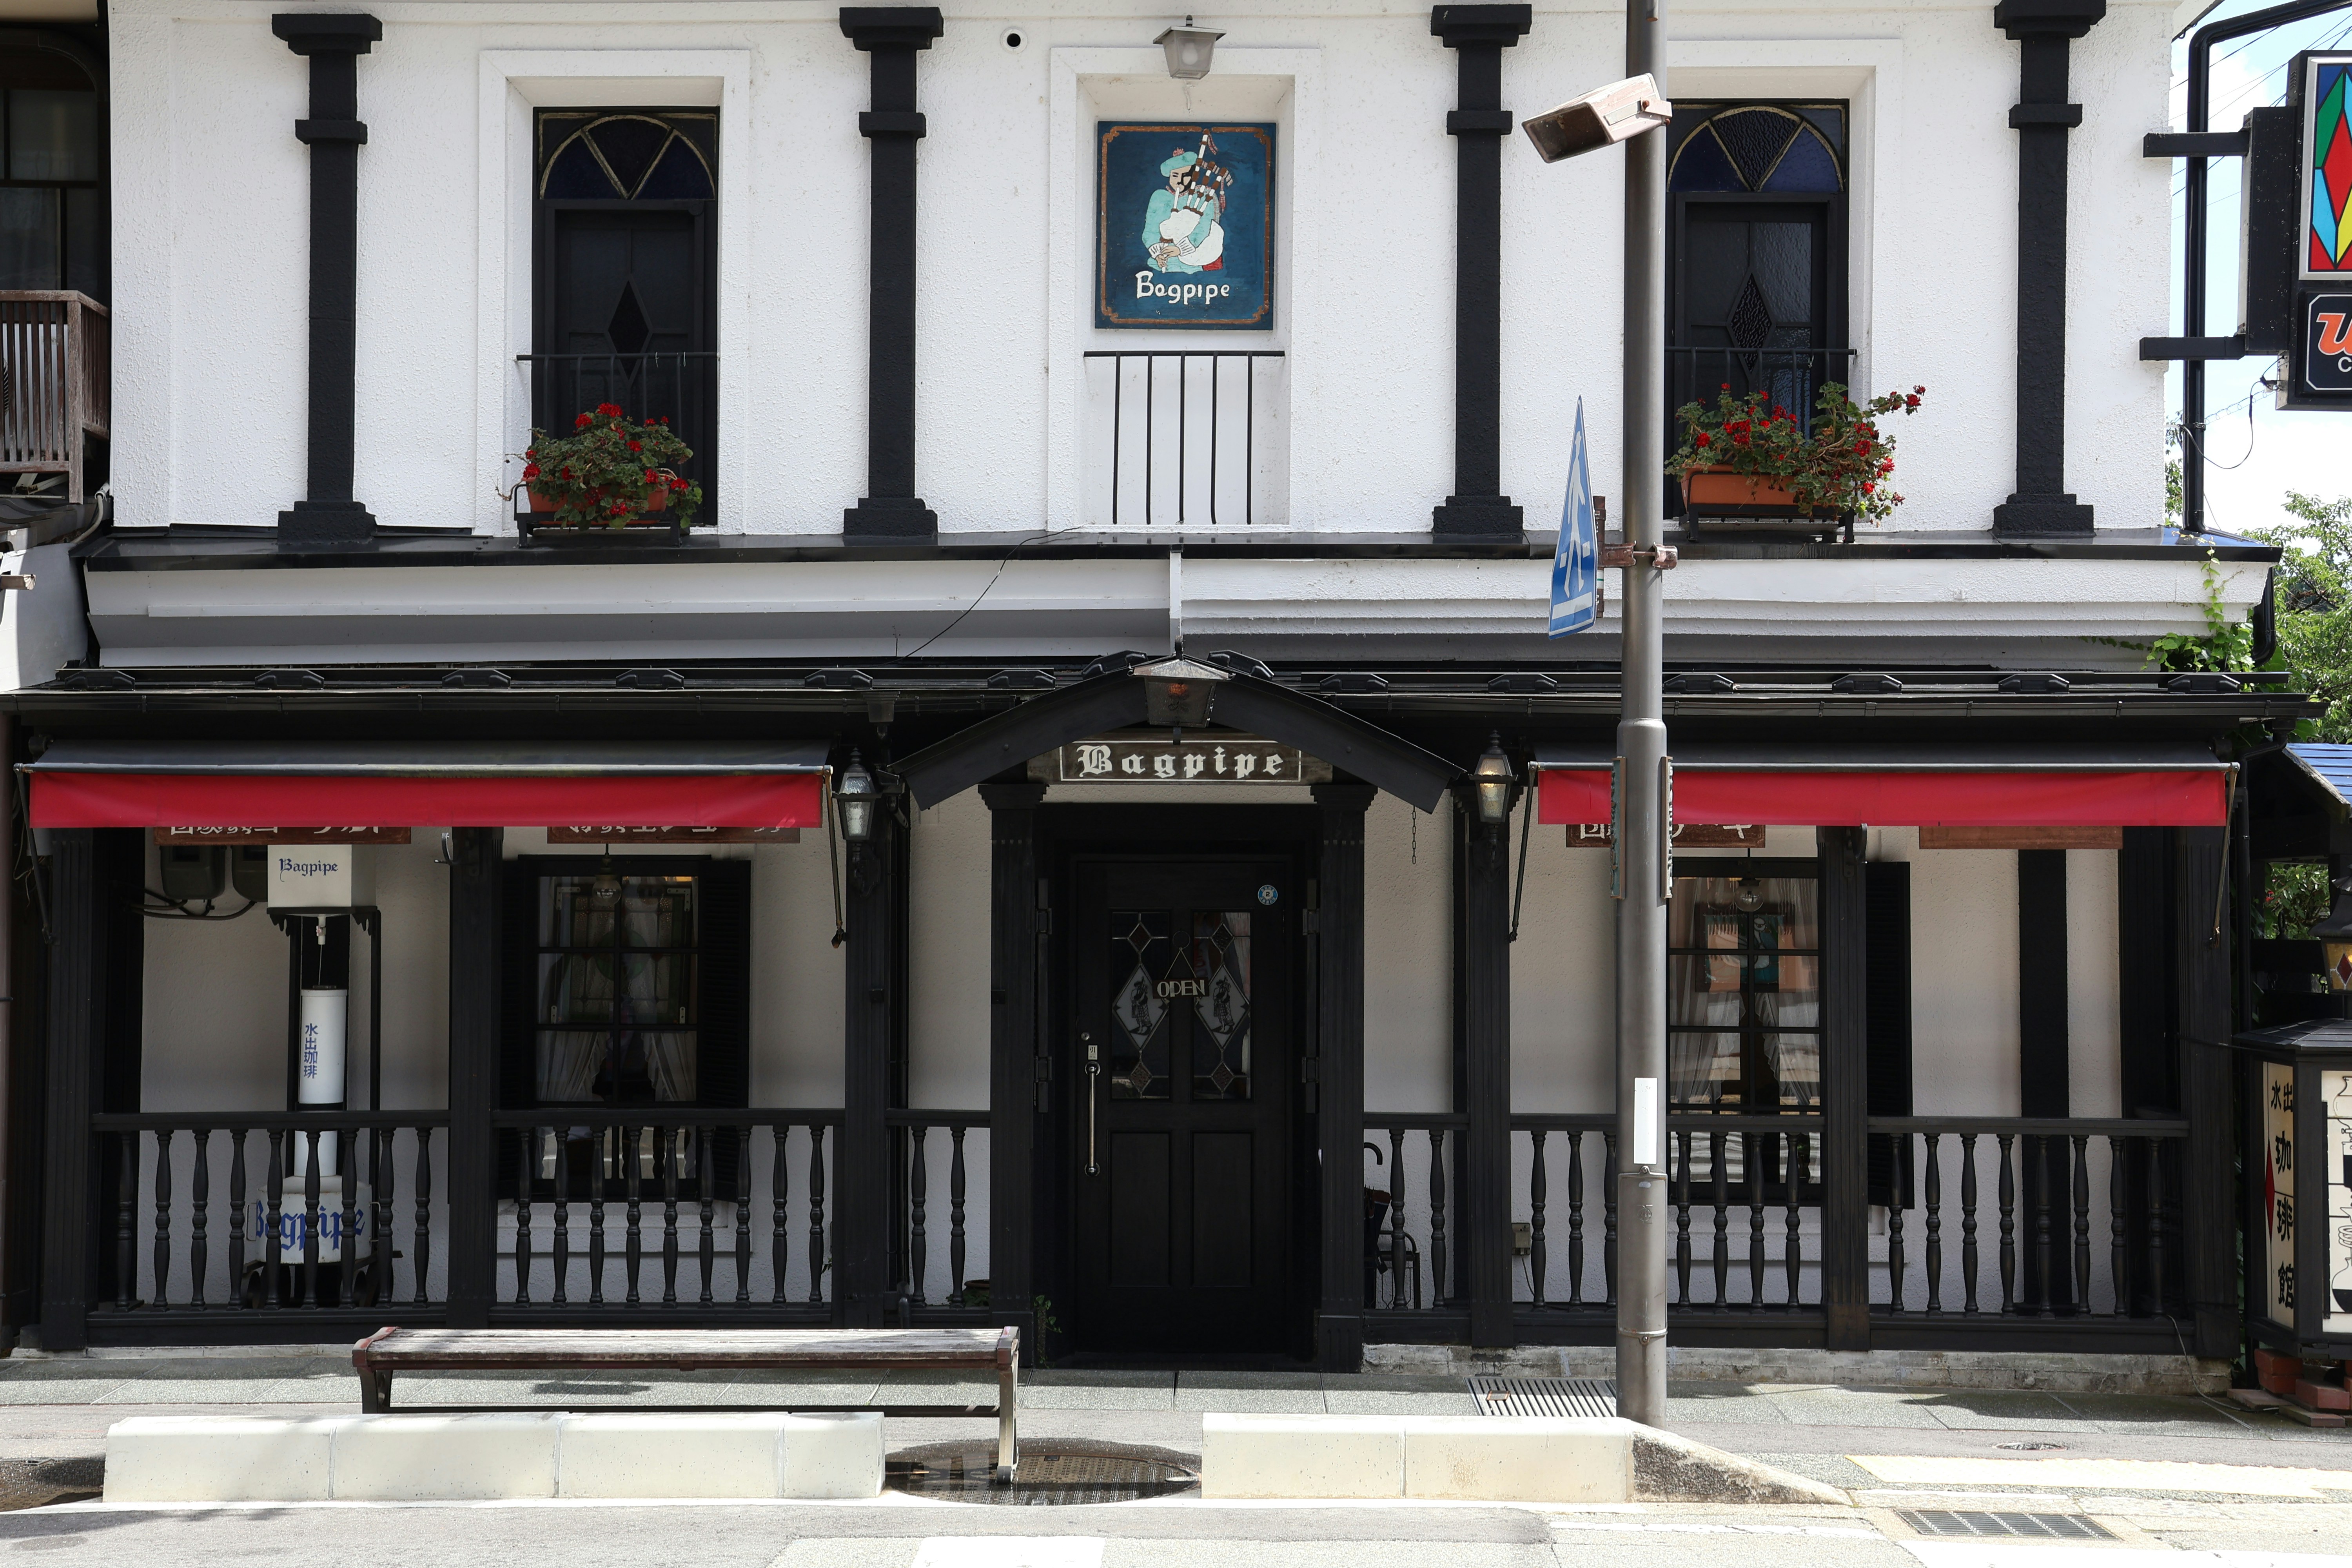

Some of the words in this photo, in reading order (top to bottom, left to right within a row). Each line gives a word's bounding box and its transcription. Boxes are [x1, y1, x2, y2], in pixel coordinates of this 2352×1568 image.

[1135, 270, 1230, 305] Bagpipe
[1076, 745, 1284, 779] Bagpipe
[278, 858, 338, 882] Bagpipe
[1157, 980, 1205, 997] OPEN
[304, 1023, 318, 1079] 水出珈琲
[256, 1200, 365, 1251] Bgpipe
